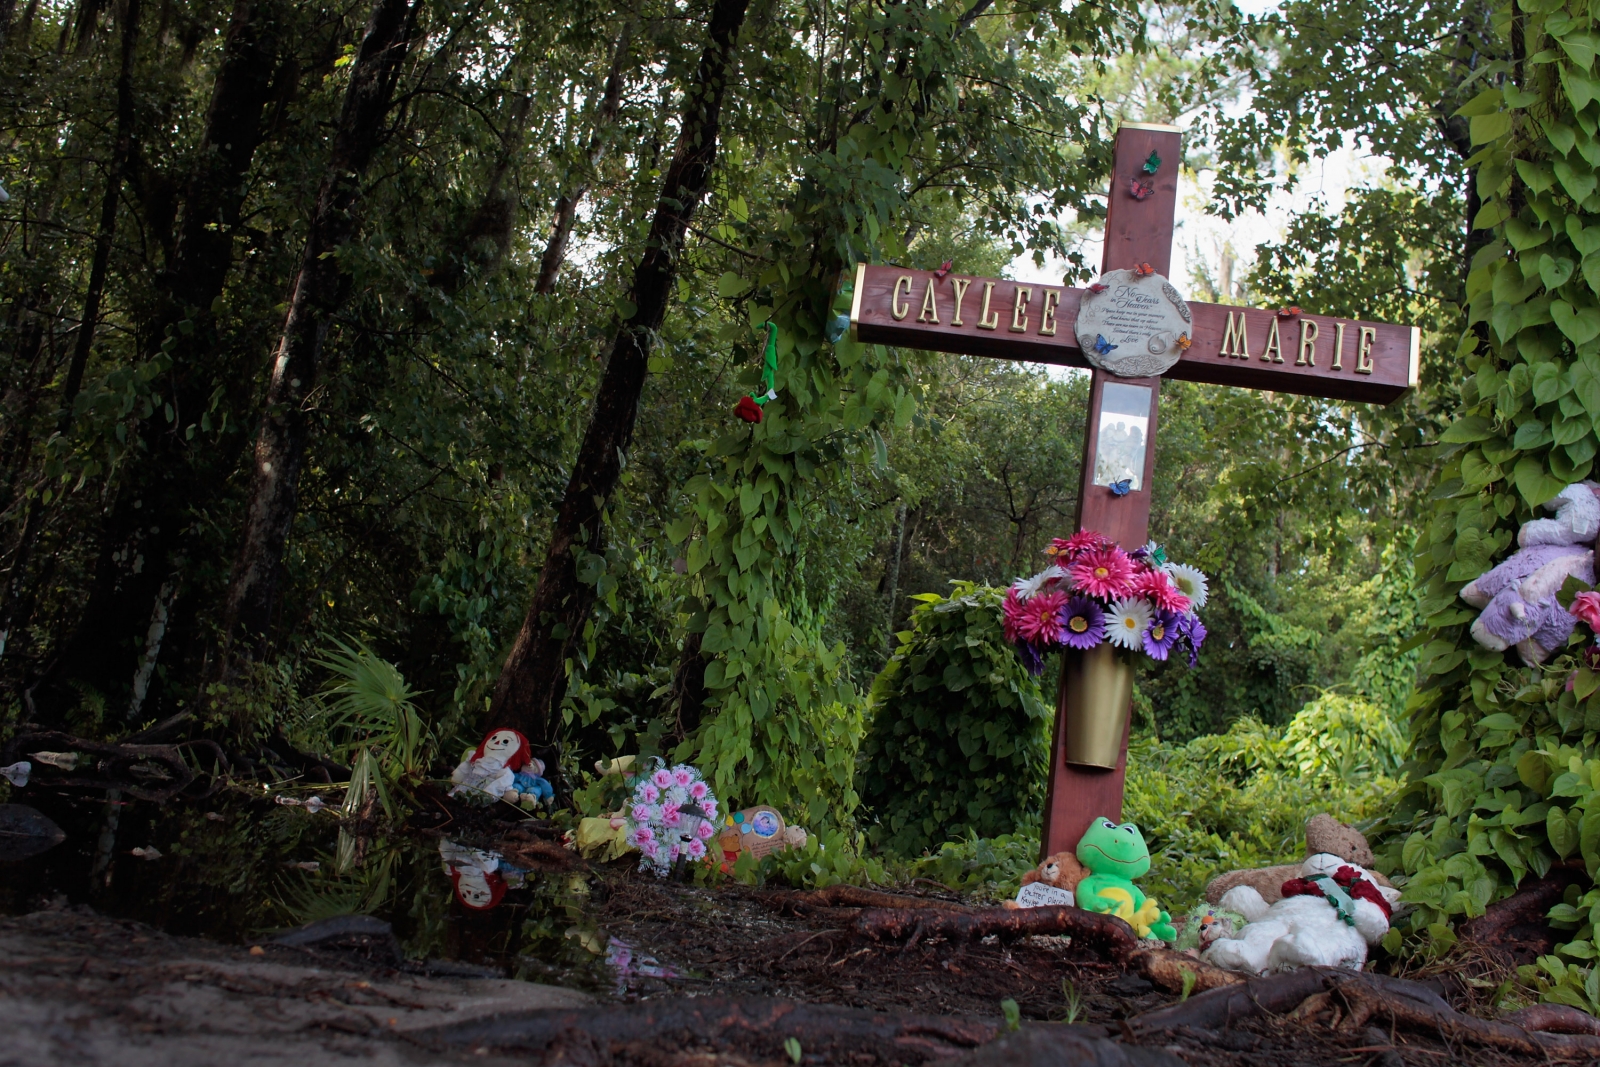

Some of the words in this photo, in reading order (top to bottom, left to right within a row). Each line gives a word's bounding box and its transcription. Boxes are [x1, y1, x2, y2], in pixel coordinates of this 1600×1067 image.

[1114, 286, 1138, 297] No
[1135, 294, 1159, 304] Tears
[891, 275, 1061, 336] CAYLEE
[1218, 311, 1376, 374] MARIE
[1120, 335, 1138, 343] Love
[1024, 888, 1045, 900] better
